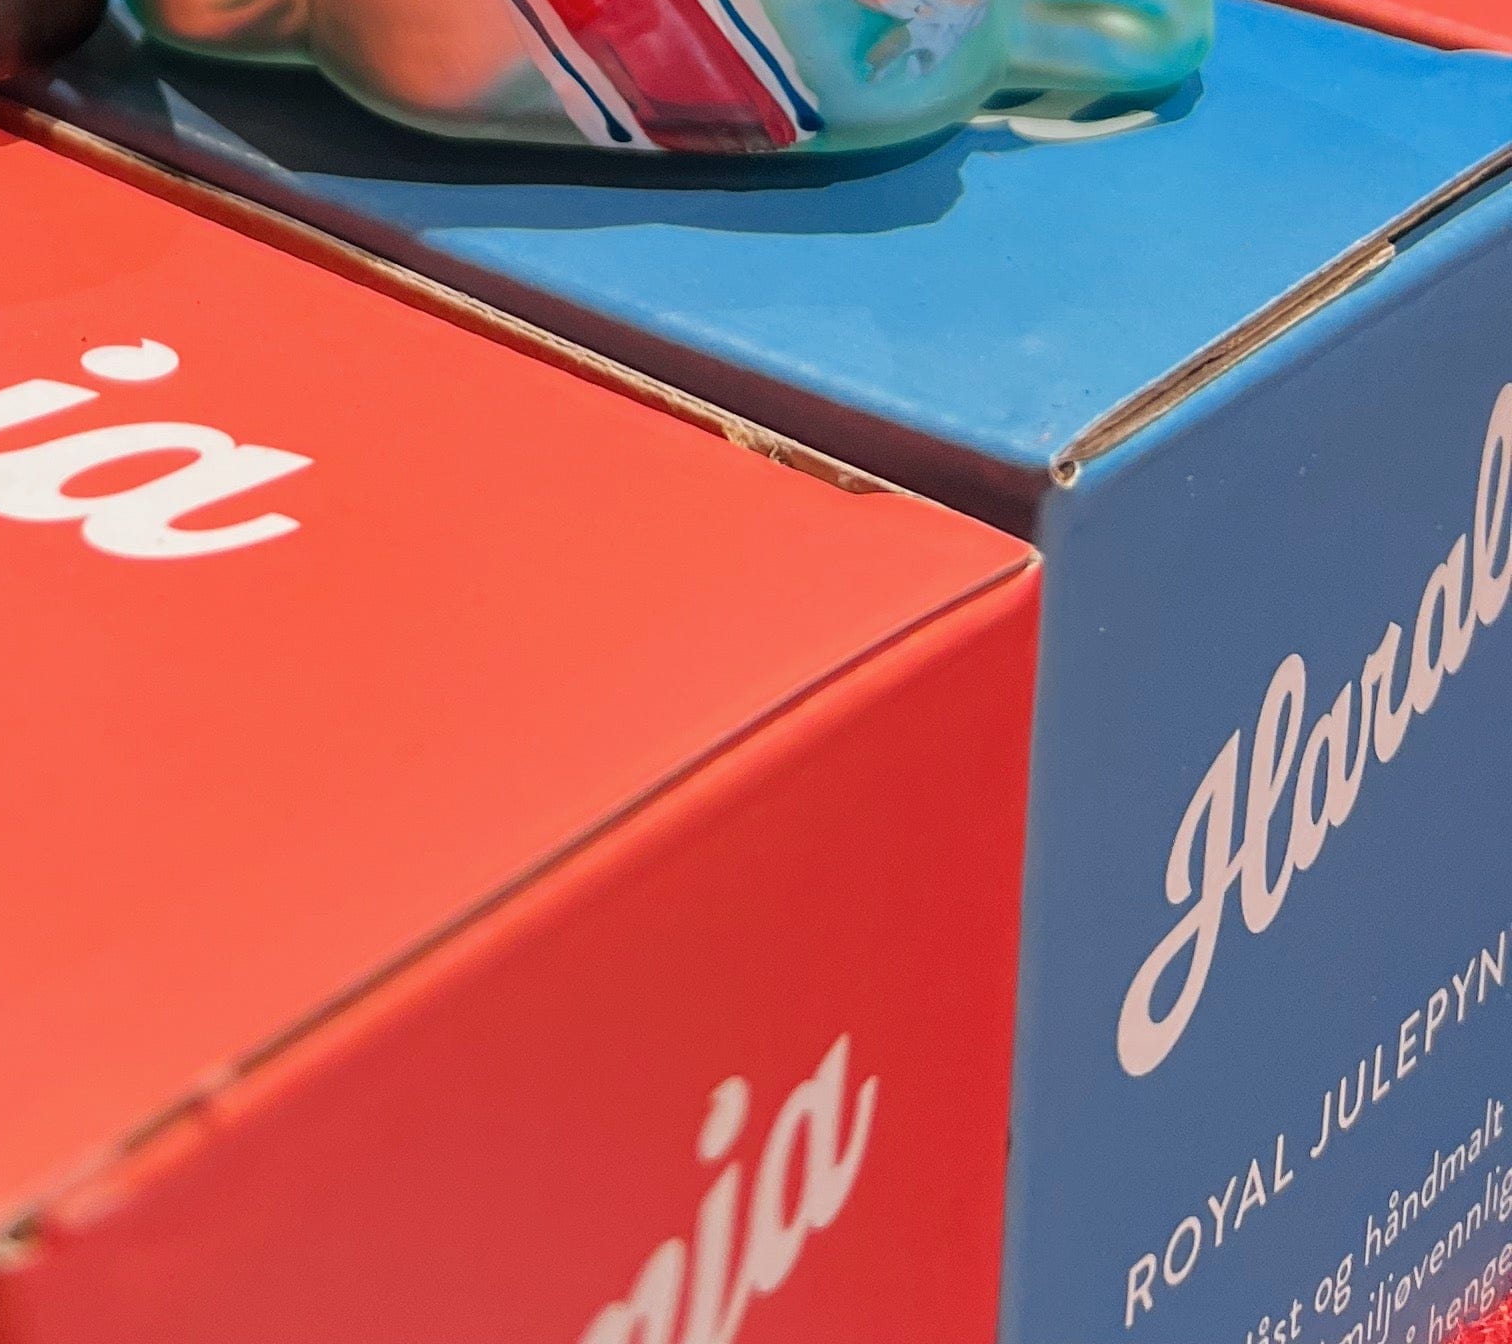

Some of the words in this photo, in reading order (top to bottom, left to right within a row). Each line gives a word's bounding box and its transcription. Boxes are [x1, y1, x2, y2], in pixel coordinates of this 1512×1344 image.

[1117, 382, 1512, 1077] Haral
[1125, 1134, 1294, 1330] ROYAL
[1309, 930, 1510, 1159] JULEPYN
[1314, 1253, 1354, 1316] og
[1363, 1097, 1505, 1267] håndmalt
